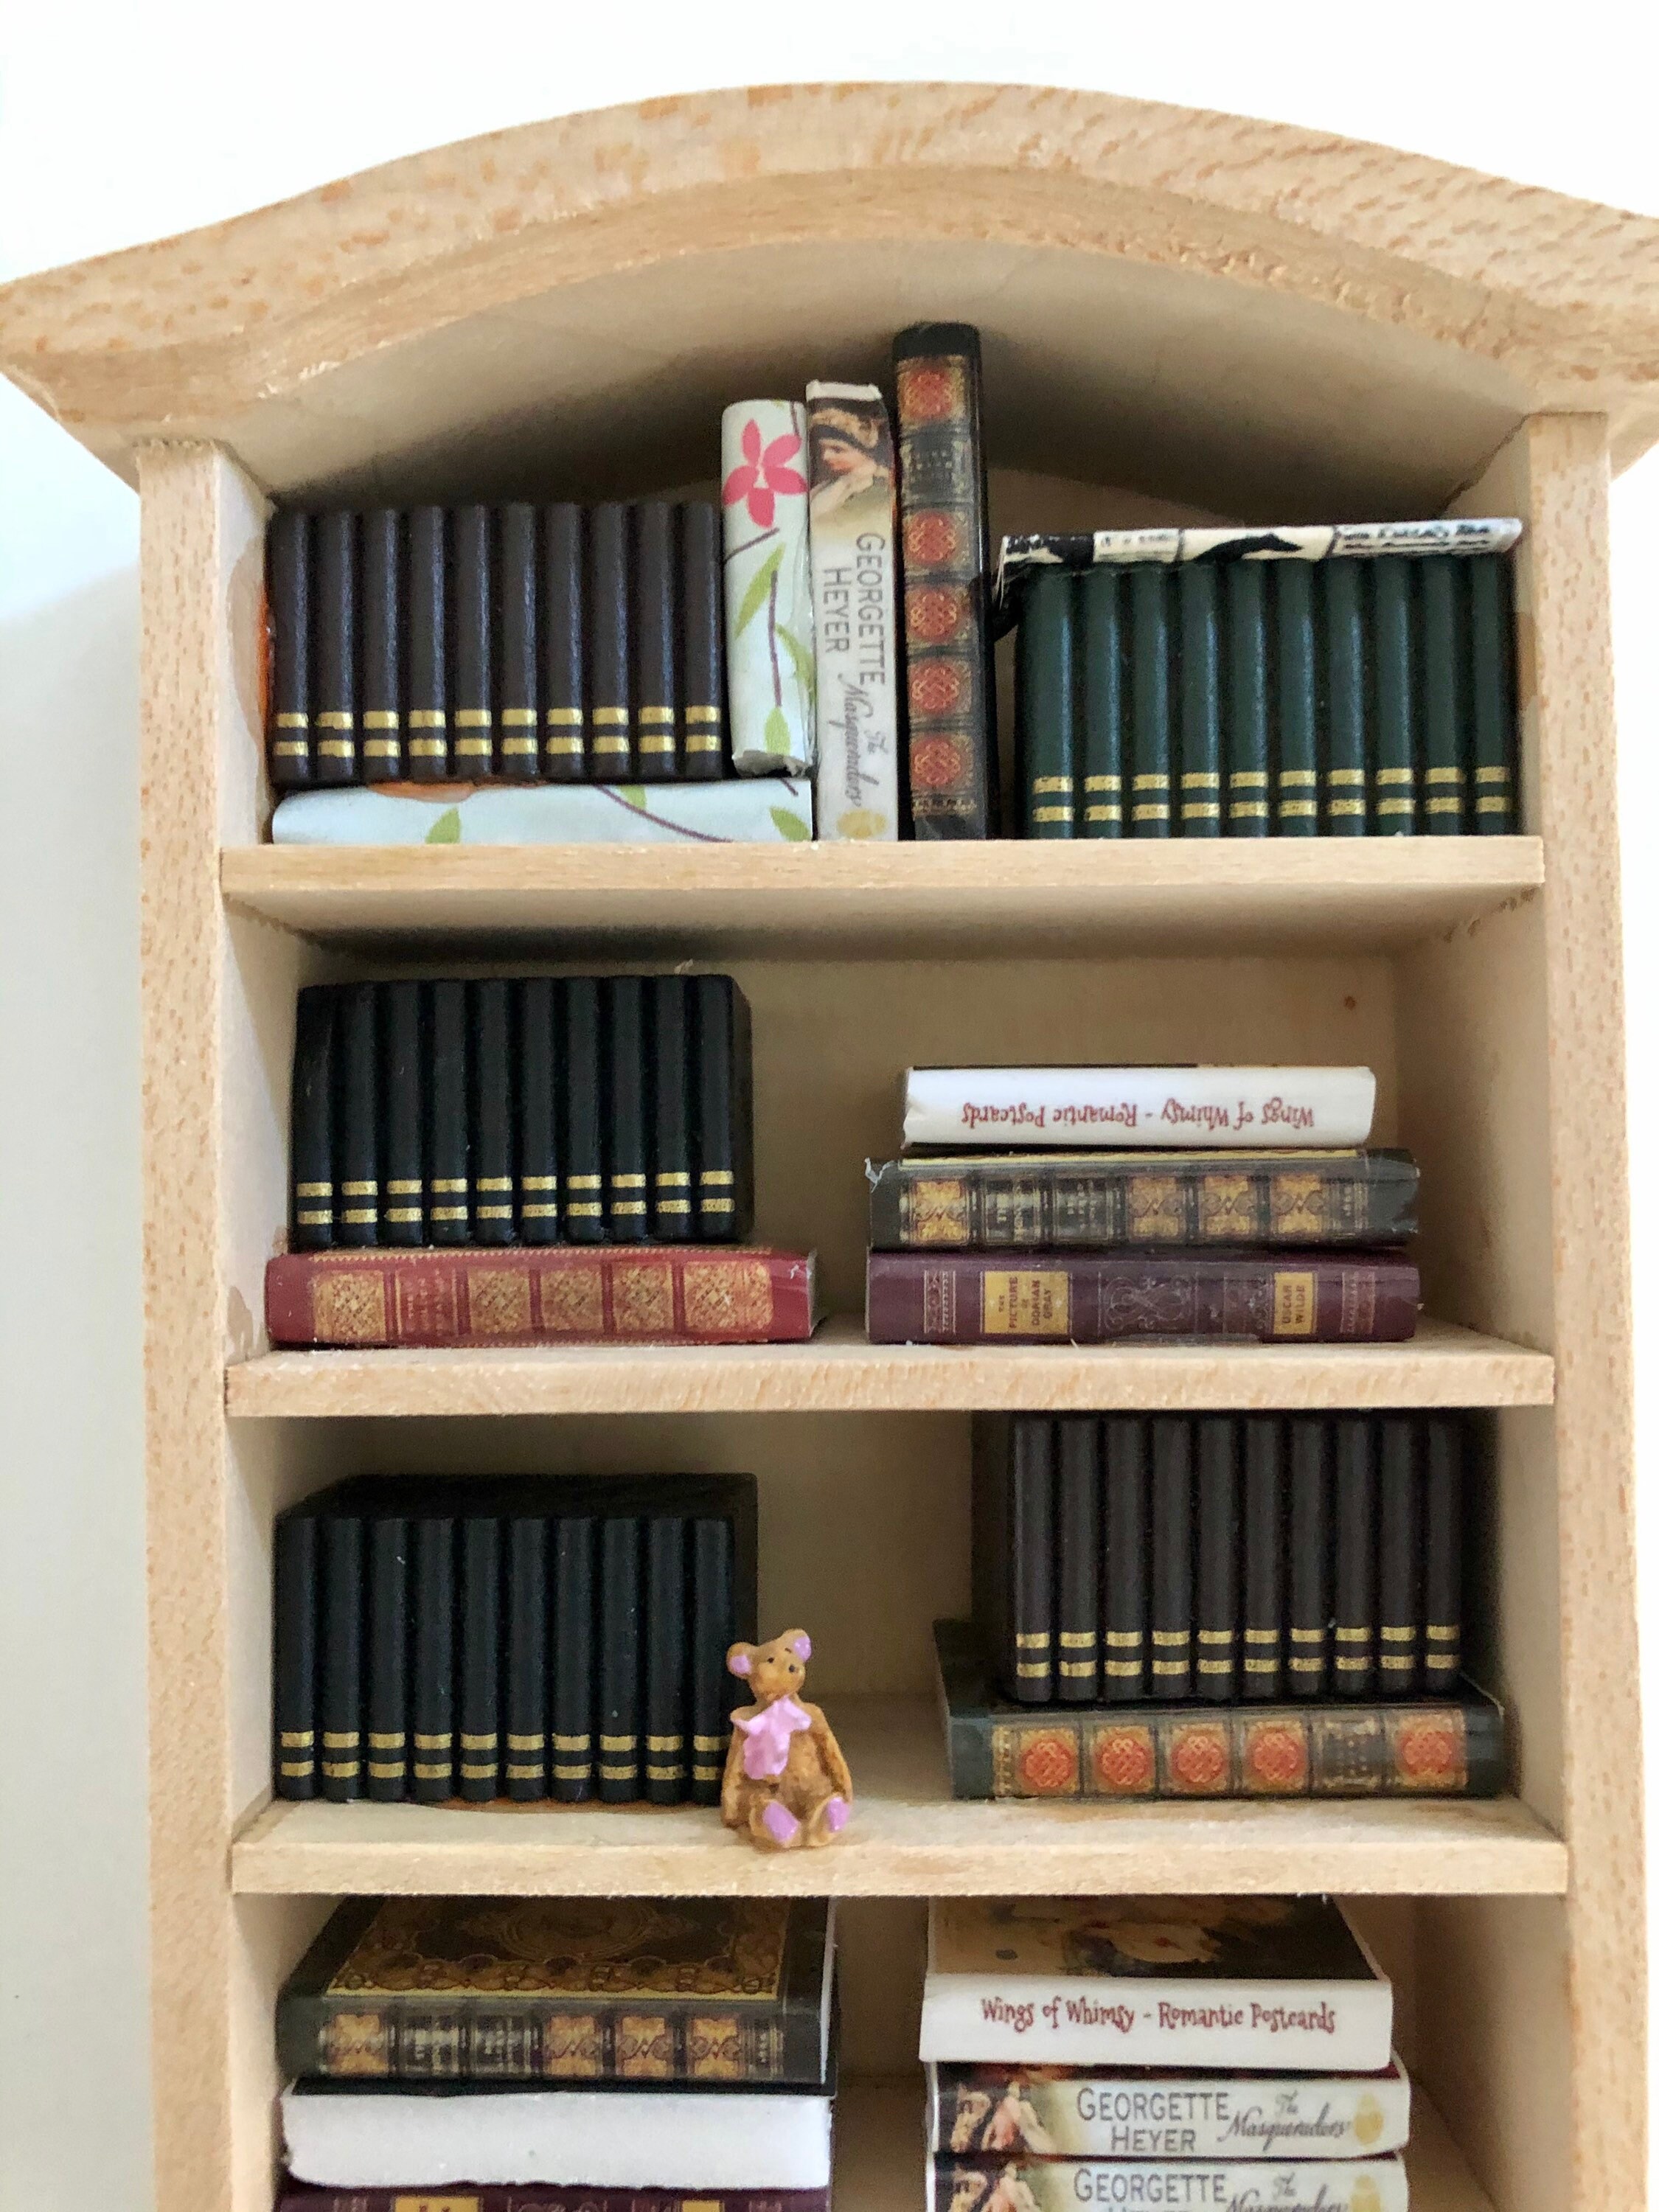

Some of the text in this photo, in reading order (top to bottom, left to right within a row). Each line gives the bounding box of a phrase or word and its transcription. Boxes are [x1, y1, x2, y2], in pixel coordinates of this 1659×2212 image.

[823, 567, 852, 653] HEYER
[856, 532, 886, 685] GEORGETTE
[961, 1102, 1046, 1129] Postcards
[1052, 1102, 1138, 1128] Romantic
[1161, 1098, 1229, 1131] Whimsy
[1233, 1101, 1253, 1130] of
[1262, 1096, 1315, 1129] Wings
[1009, 1277, 1018, 1328] PICTURE
[1032, 1280, 1040, 1326] DORIAN
[1043, 1289, 1052, 1319] GRAY
[1295, 1285, 1305, 1324] WILDE
[980, 1996, 1034, 2033] Wings
[1043, 1995, 1061, 2029] of
[1065, 1995, 1134, 2034] Whimsy
[1158, 2001, 1244, 2029] Romantic
[1251, 2000, 1335, 2034] Postcards
[1076, 2087, 1230, 2121] GEORGETTE
[1111, 2125, 1196, 2152] HEYER
[1074, 2168, 1227, 2202] GEORGETTE
